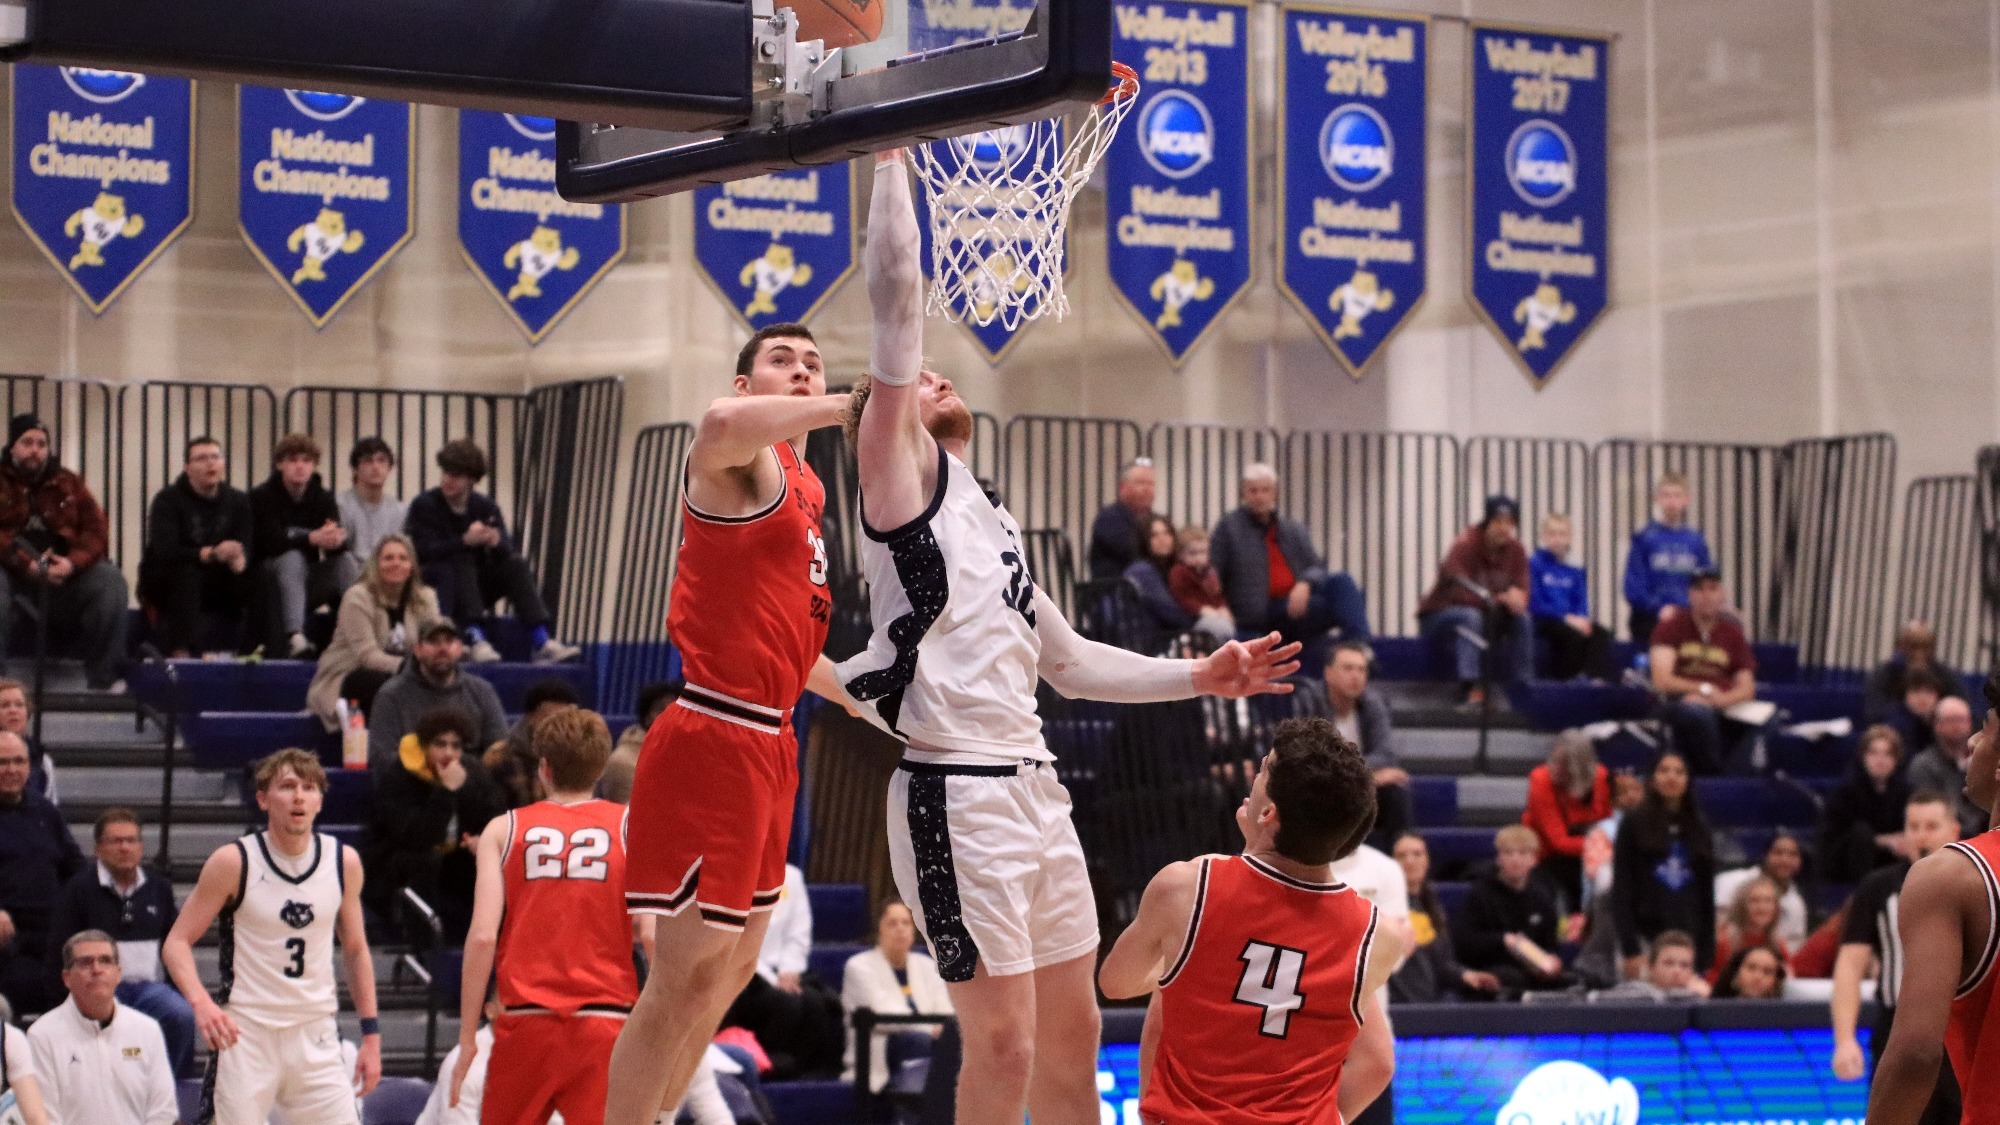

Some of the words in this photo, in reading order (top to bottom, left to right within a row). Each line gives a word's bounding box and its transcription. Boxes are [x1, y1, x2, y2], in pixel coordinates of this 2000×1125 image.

[1115, 5, 1235, 50] Volleyball
[1296, 20, 1414, 64] Volleyball
[1144, 47, 1208, 85] 2013
[1325, 60, 1388, 97] 2016
[1484, 37, 1597, 80] Volleyball
[1512, 76, 1570, 113] 2017
[48, 110, 155, 150] National
[270, 127, 374, 167] National
[1150, 130, 1213, 160] NCAA
[30, 142, 170, 189] Champions
[1330, 144, 1393, 175] NCAA
[1515, 160, 1575, 191] NCAA
[252, 159, 390, 205] Champions
[707, 196, 835, 241] Champions
[1131, 184, 1221, 221] National
[1312, 197, 1402, 234] National
[1117, 214, 1234, 256] Champions
[1298, 226, 1416, 268] Champions
[1499, 211, 1584, 248] National
[1485, 240, 1598, 280] Champions
[523, 826, 611, 882] 22
[284, 937, 306, 978] 3
[1231, 938, 1308, 1040] 4
